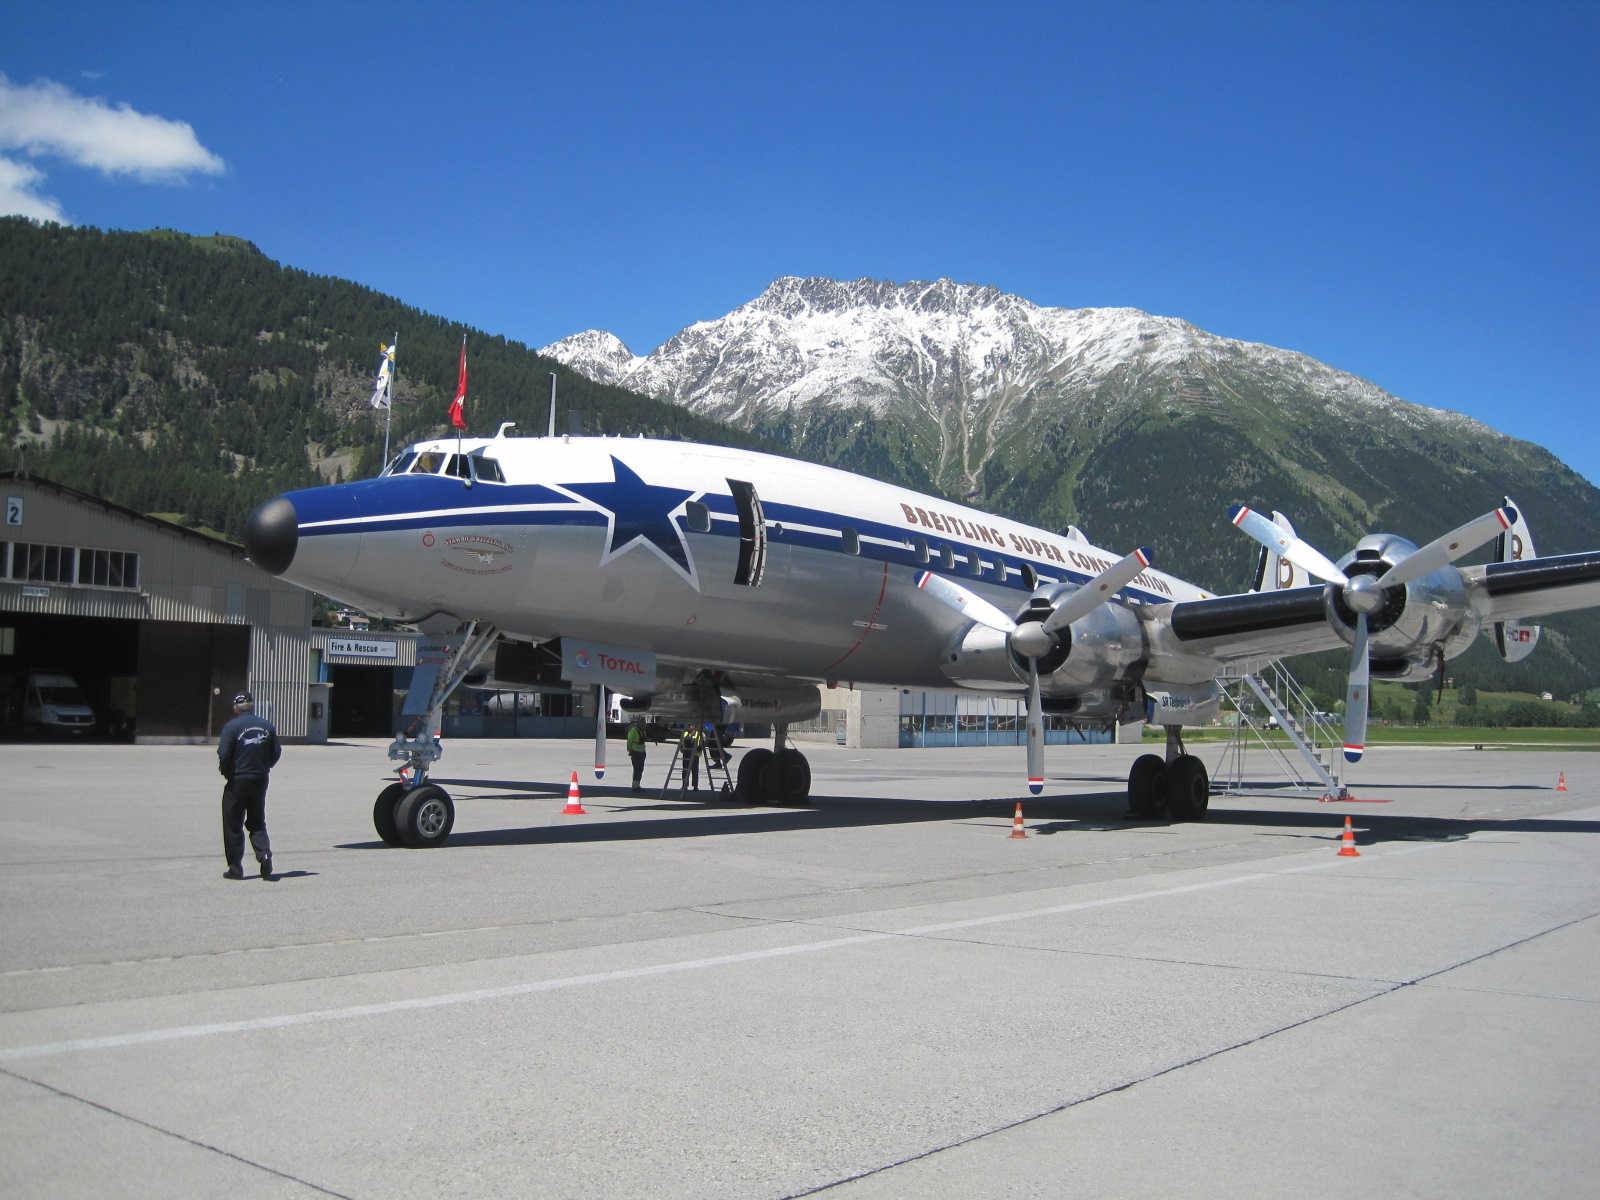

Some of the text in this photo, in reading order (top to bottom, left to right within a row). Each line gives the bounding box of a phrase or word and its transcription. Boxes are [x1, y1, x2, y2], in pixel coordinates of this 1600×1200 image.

[10, 506, 20, 523] 2
[900, 503, 1006, 548] BREITLING
[1009, 533, 1066, 563] SUPER
[331, 642, 344, 651] Fire
[346, 642, 352, 652] &
[354, 643, 378, 653] Rescue
[597, 653, 645, 674] TOTAL
